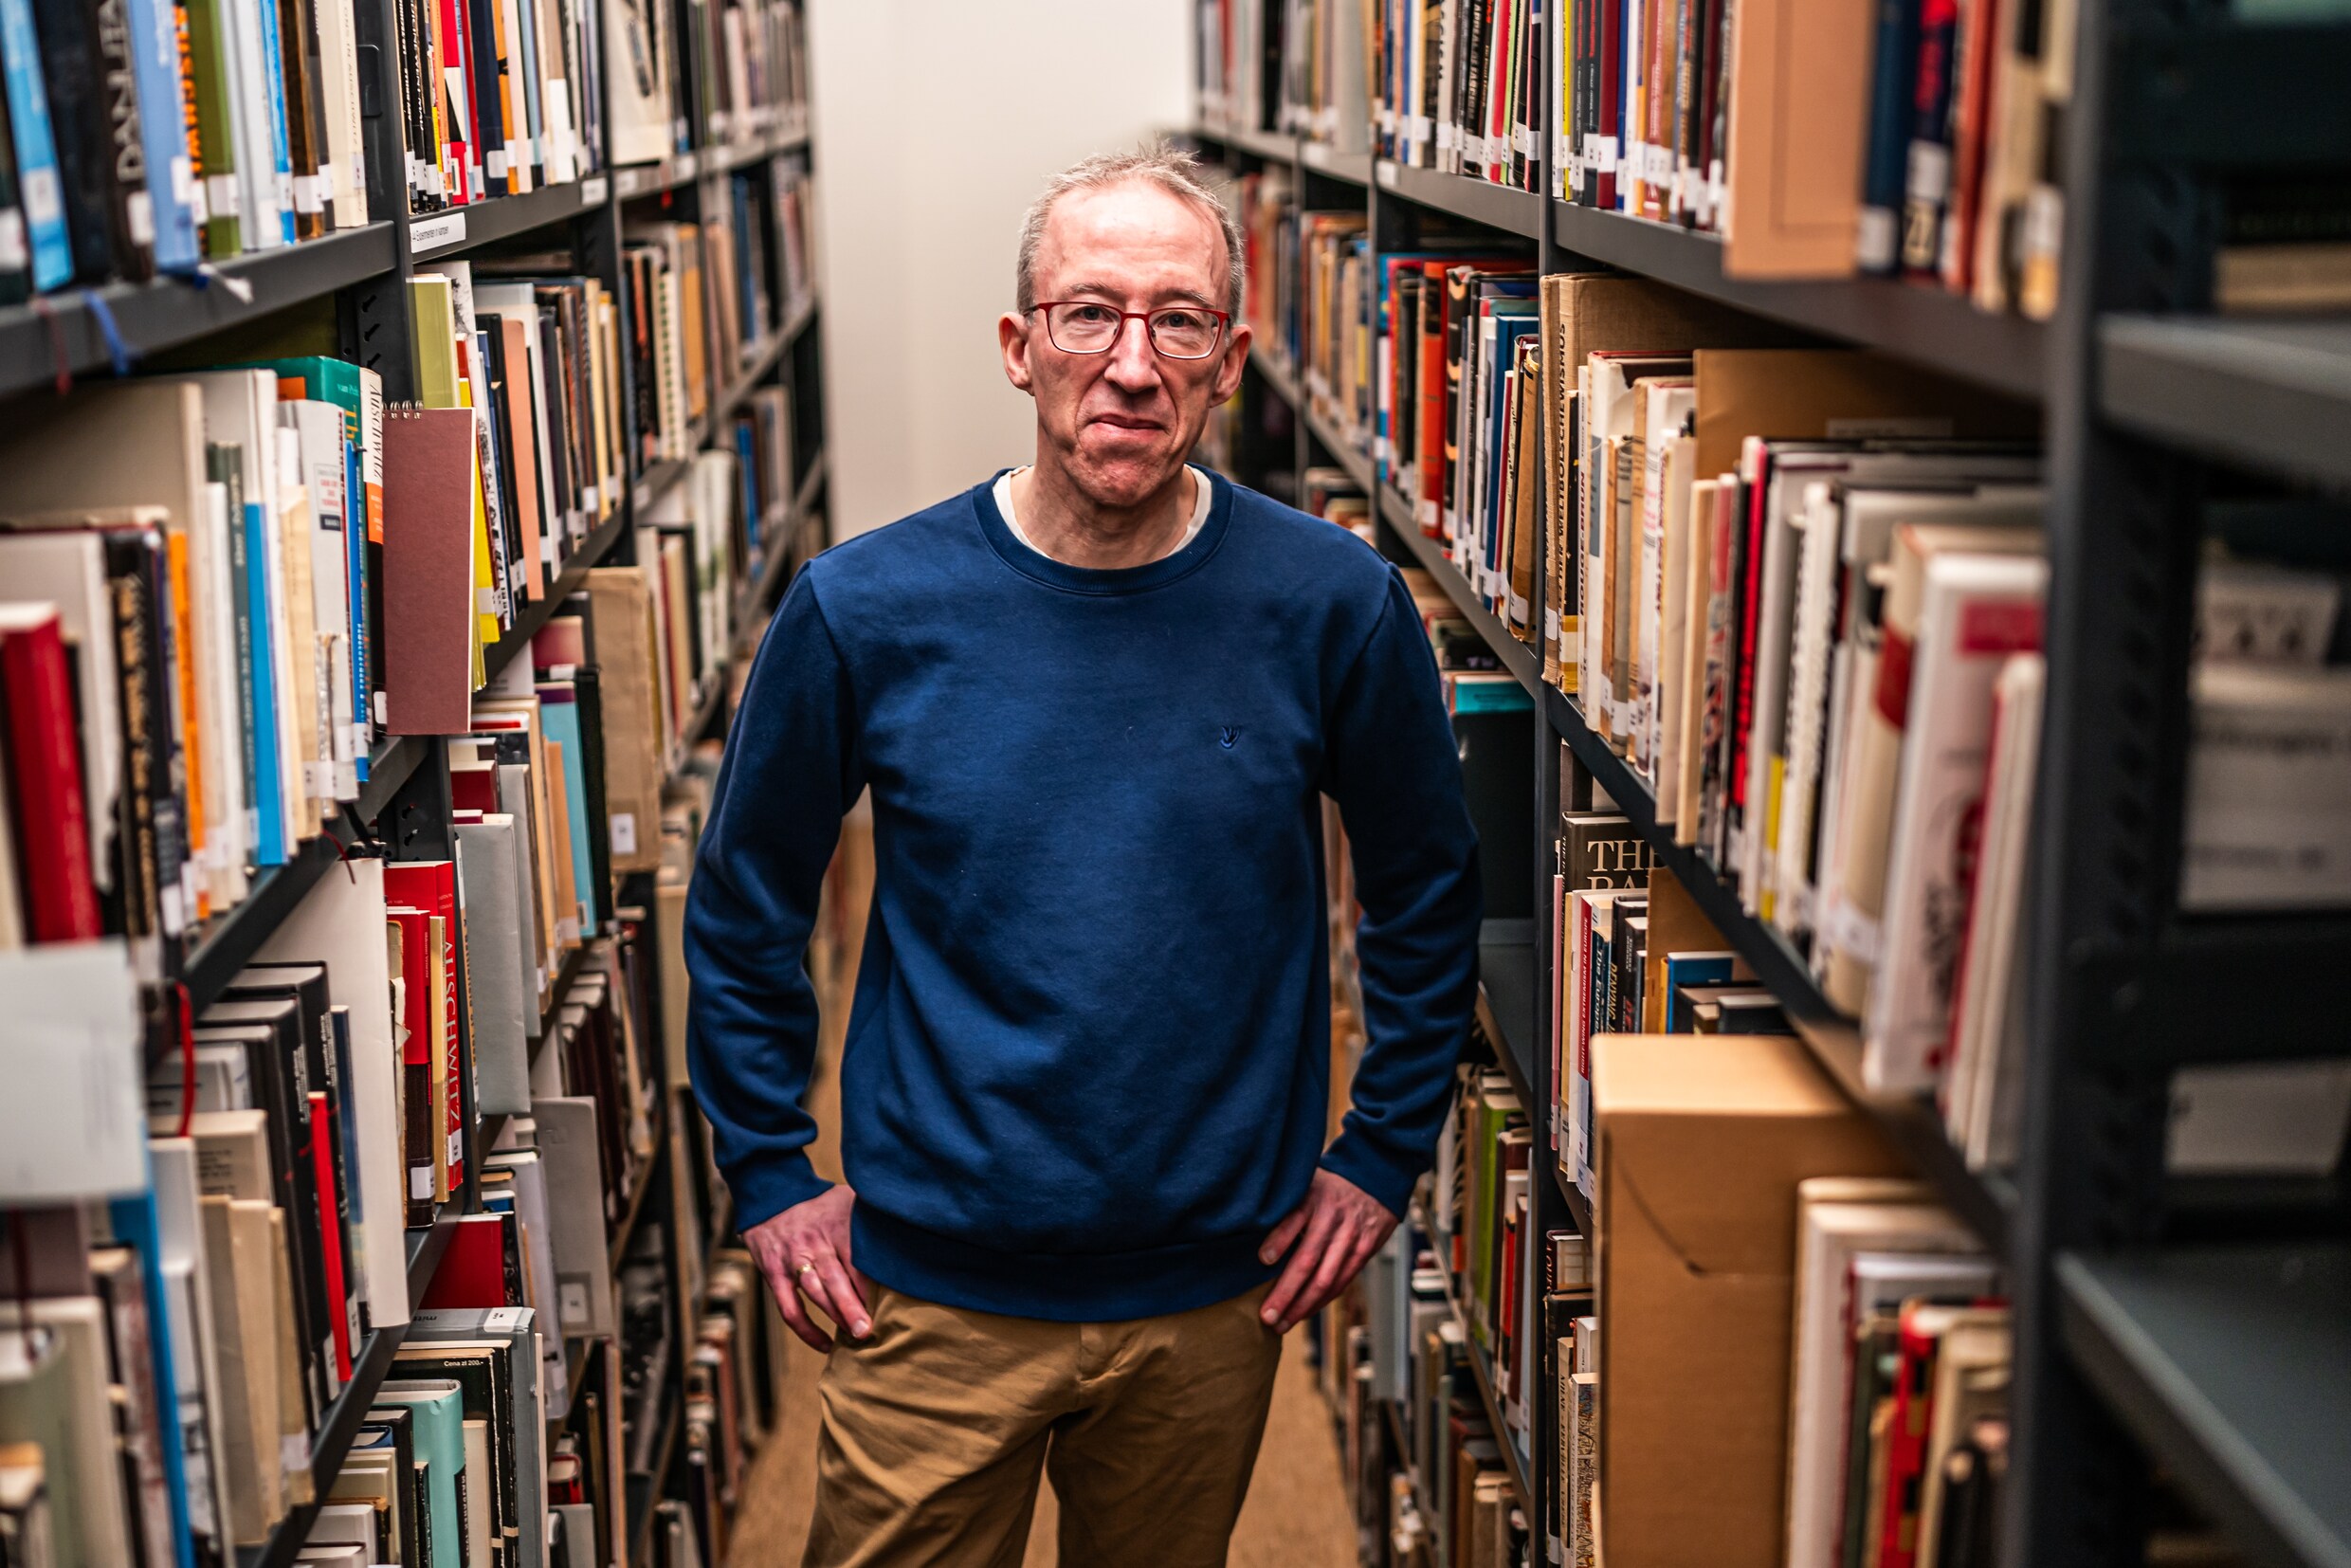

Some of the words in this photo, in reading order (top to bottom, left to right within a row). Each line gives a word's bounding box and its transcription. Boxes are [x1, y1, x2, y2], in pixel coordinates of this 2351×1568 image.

[1472, 3, 1482, 48] APPEAL
[1467, 65, 1478, 119] FASCISM
[344, 404, 359, 440] Th
[370, 383, 384, 479] Auschwitz
[444, 940, 460, 1121] AUSCHWITZ
[1594, 977, 1602, 1034] Europe
